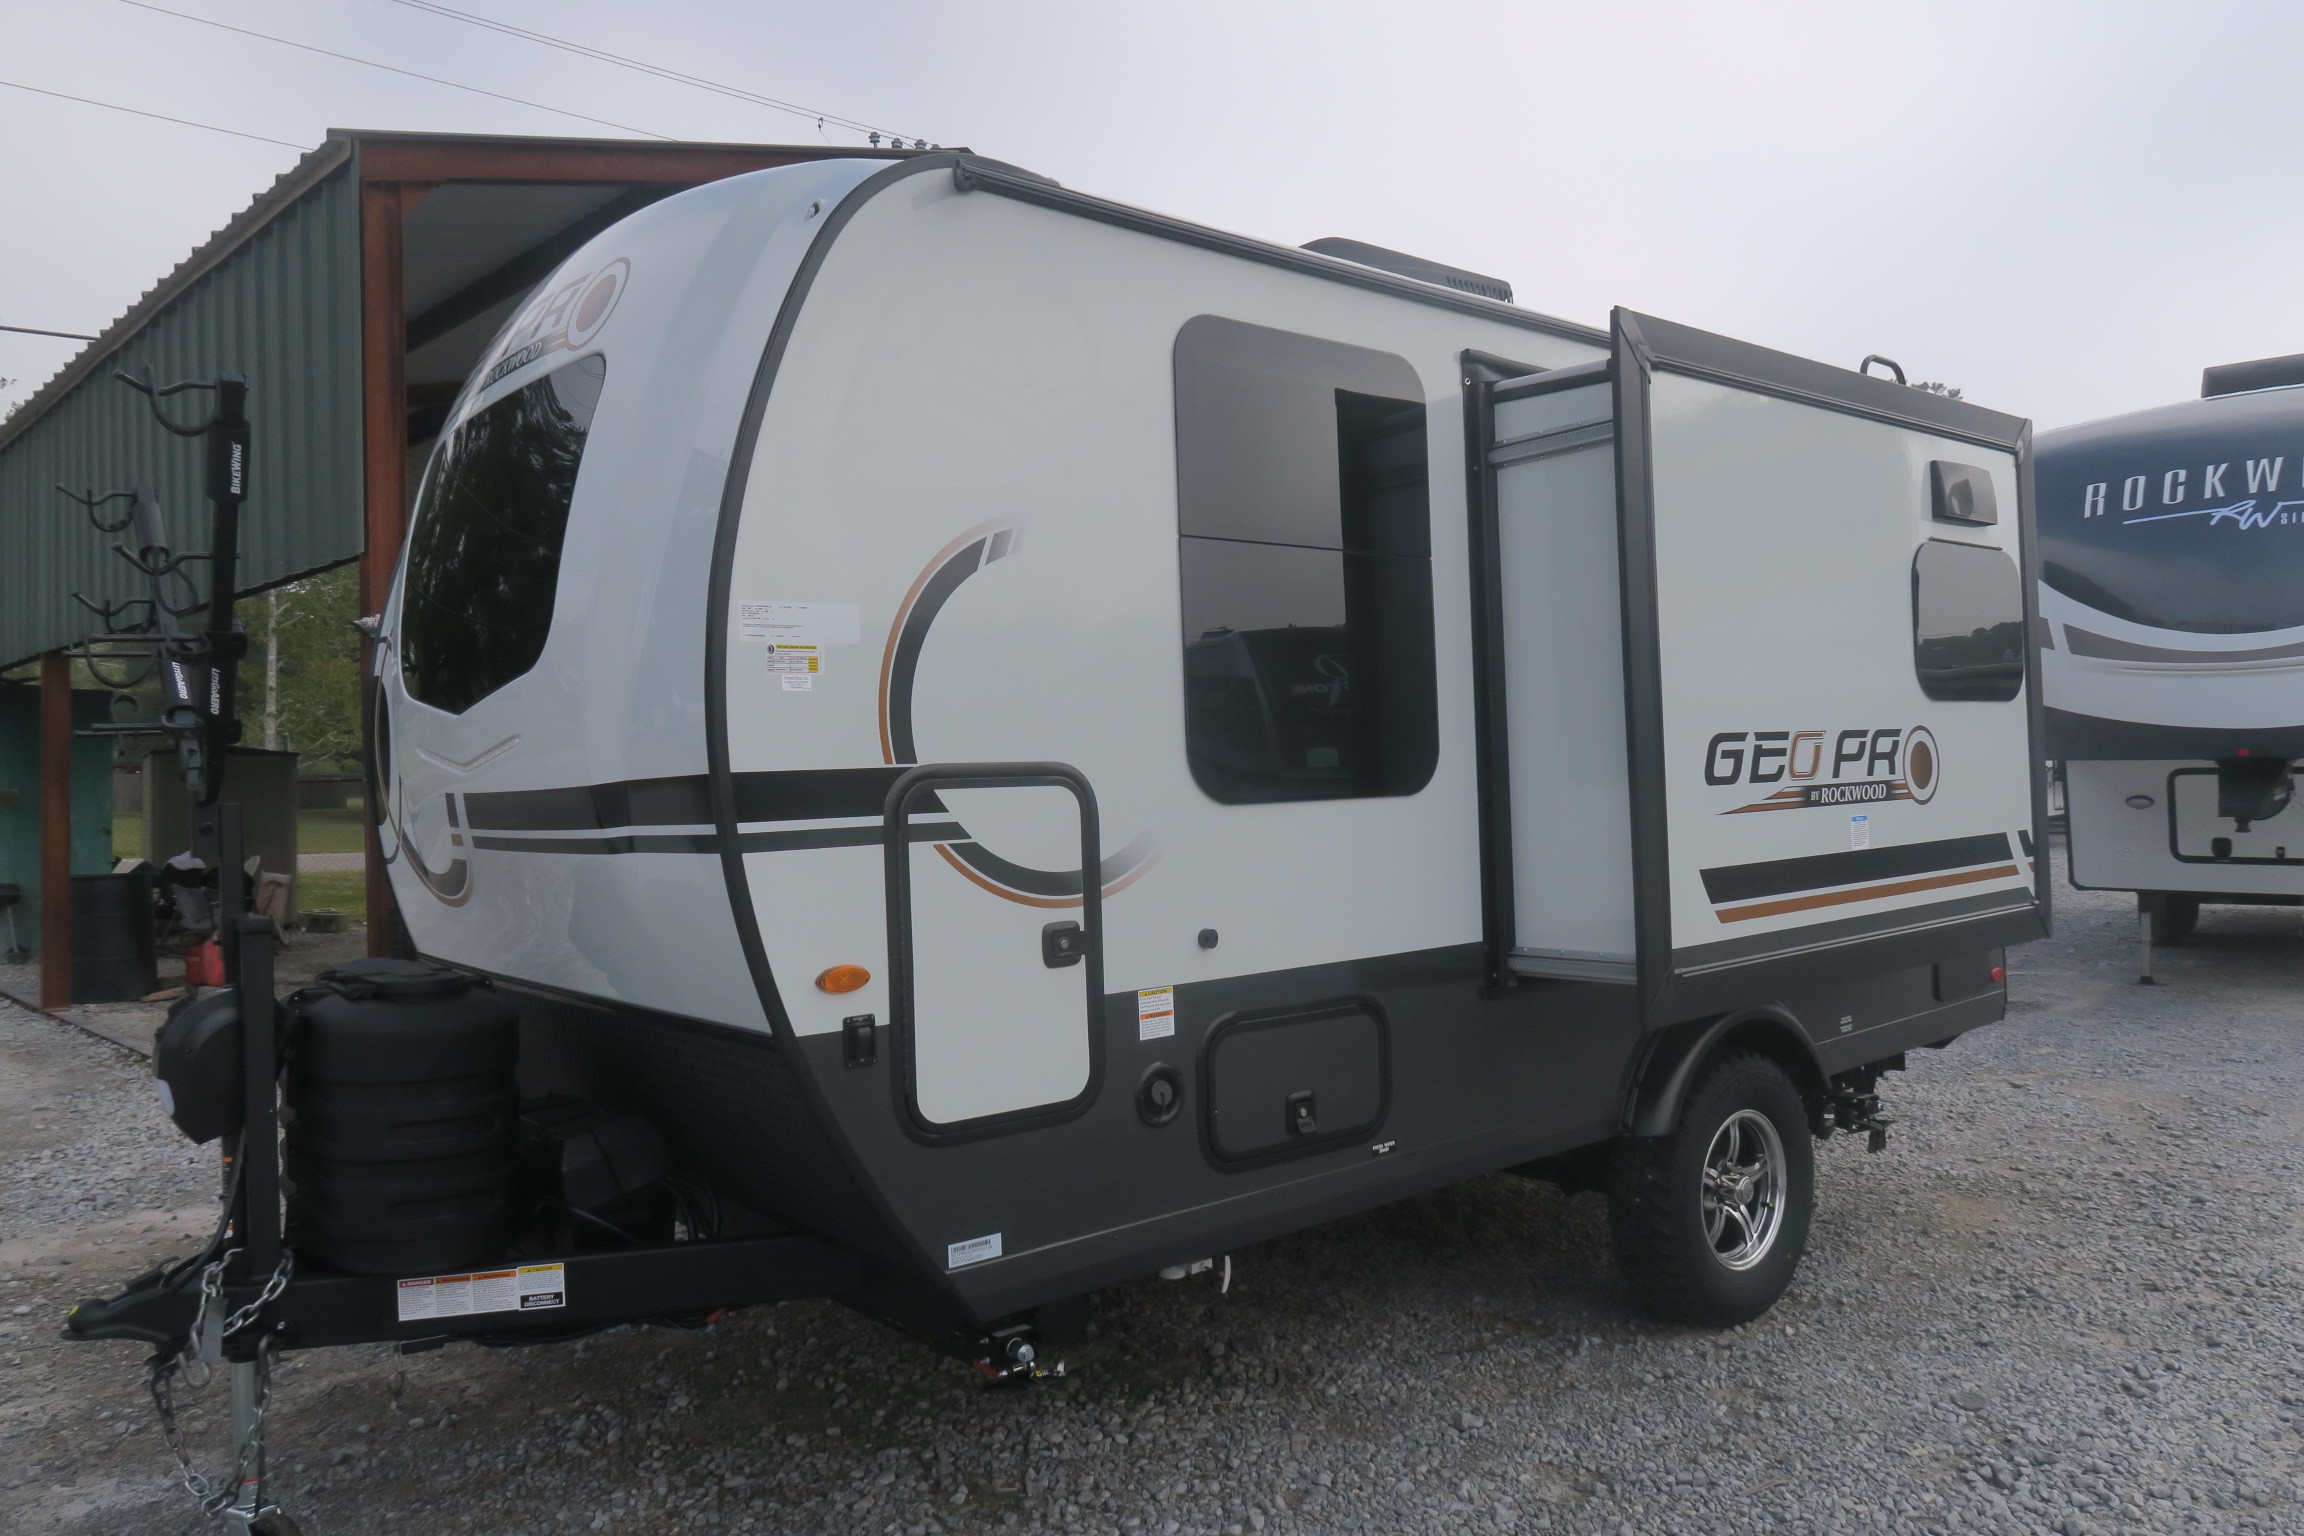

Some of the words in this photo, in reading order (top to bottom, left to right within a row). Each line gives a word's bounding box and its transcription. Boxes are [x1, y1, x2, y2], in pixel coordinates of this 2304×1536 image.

[2083, 456, 2304, 519] ROCKW
[2281, 511, 2304, 525] SI
[1704, 730, 1827, 786] GEO
[1832, 725, 1940, 805] PRO
[1810, 790, 1821, 801] BY
[1820, 783, 1887, 804] ROCKWOOD
[523, 1298, 560, 1307] DISCONNECT
